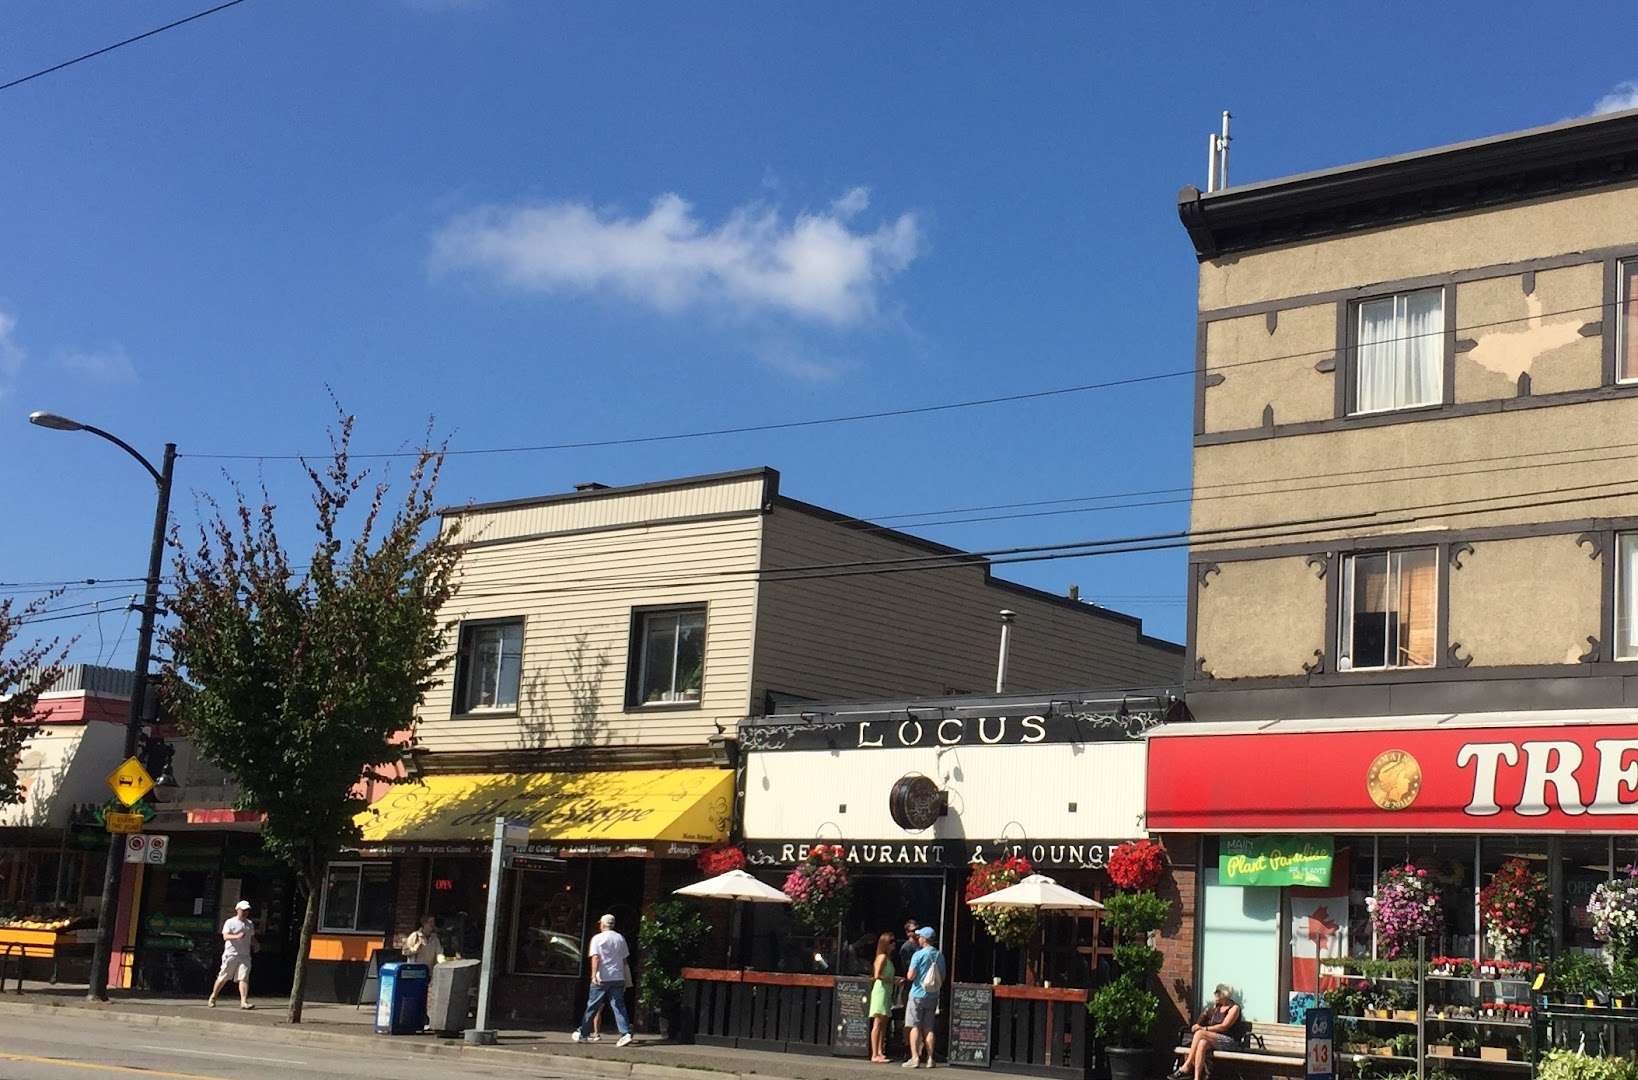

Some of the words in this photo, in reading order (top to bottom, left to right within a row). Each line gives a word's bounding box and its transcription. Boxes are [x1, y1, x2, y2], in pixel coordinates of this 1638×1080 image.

[857, 714, 1047, 748] LOCUS
[1456, 739, 1638, 816] TRE
[967, 845, 988, 865] &
[1227, 853, 1267, 878] Plant
[1312, 1044, 1328, 1063] 13
